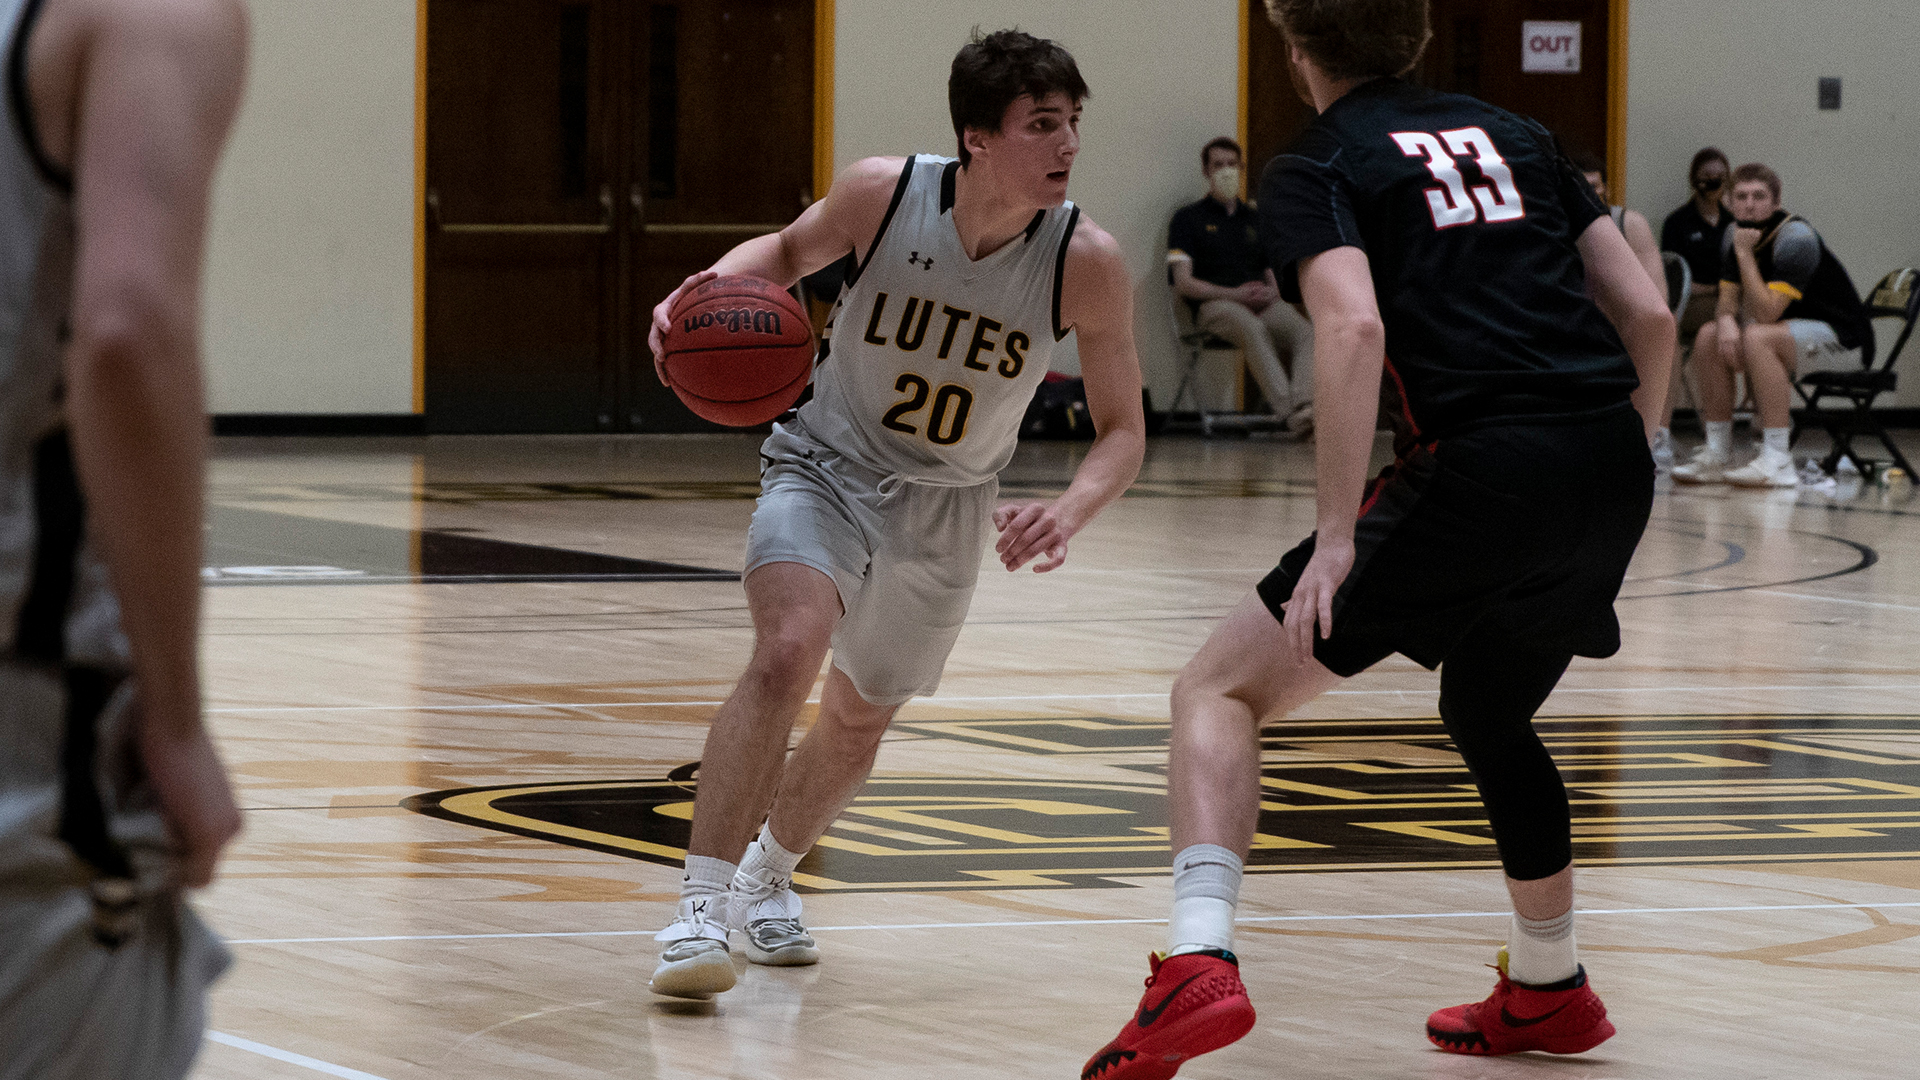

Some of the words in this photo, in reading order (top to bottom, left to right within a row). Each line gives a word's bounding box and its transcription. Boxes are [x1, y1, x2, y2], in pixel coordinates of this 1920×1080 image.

[1529, 35, 1573, 54] OUT
[1388, 125, 1526, 231] 33
[683, 307, 783, 337] Wilson
[864, 291, 1031, 380] LUTES
[881, 372, 975, 447] 20
